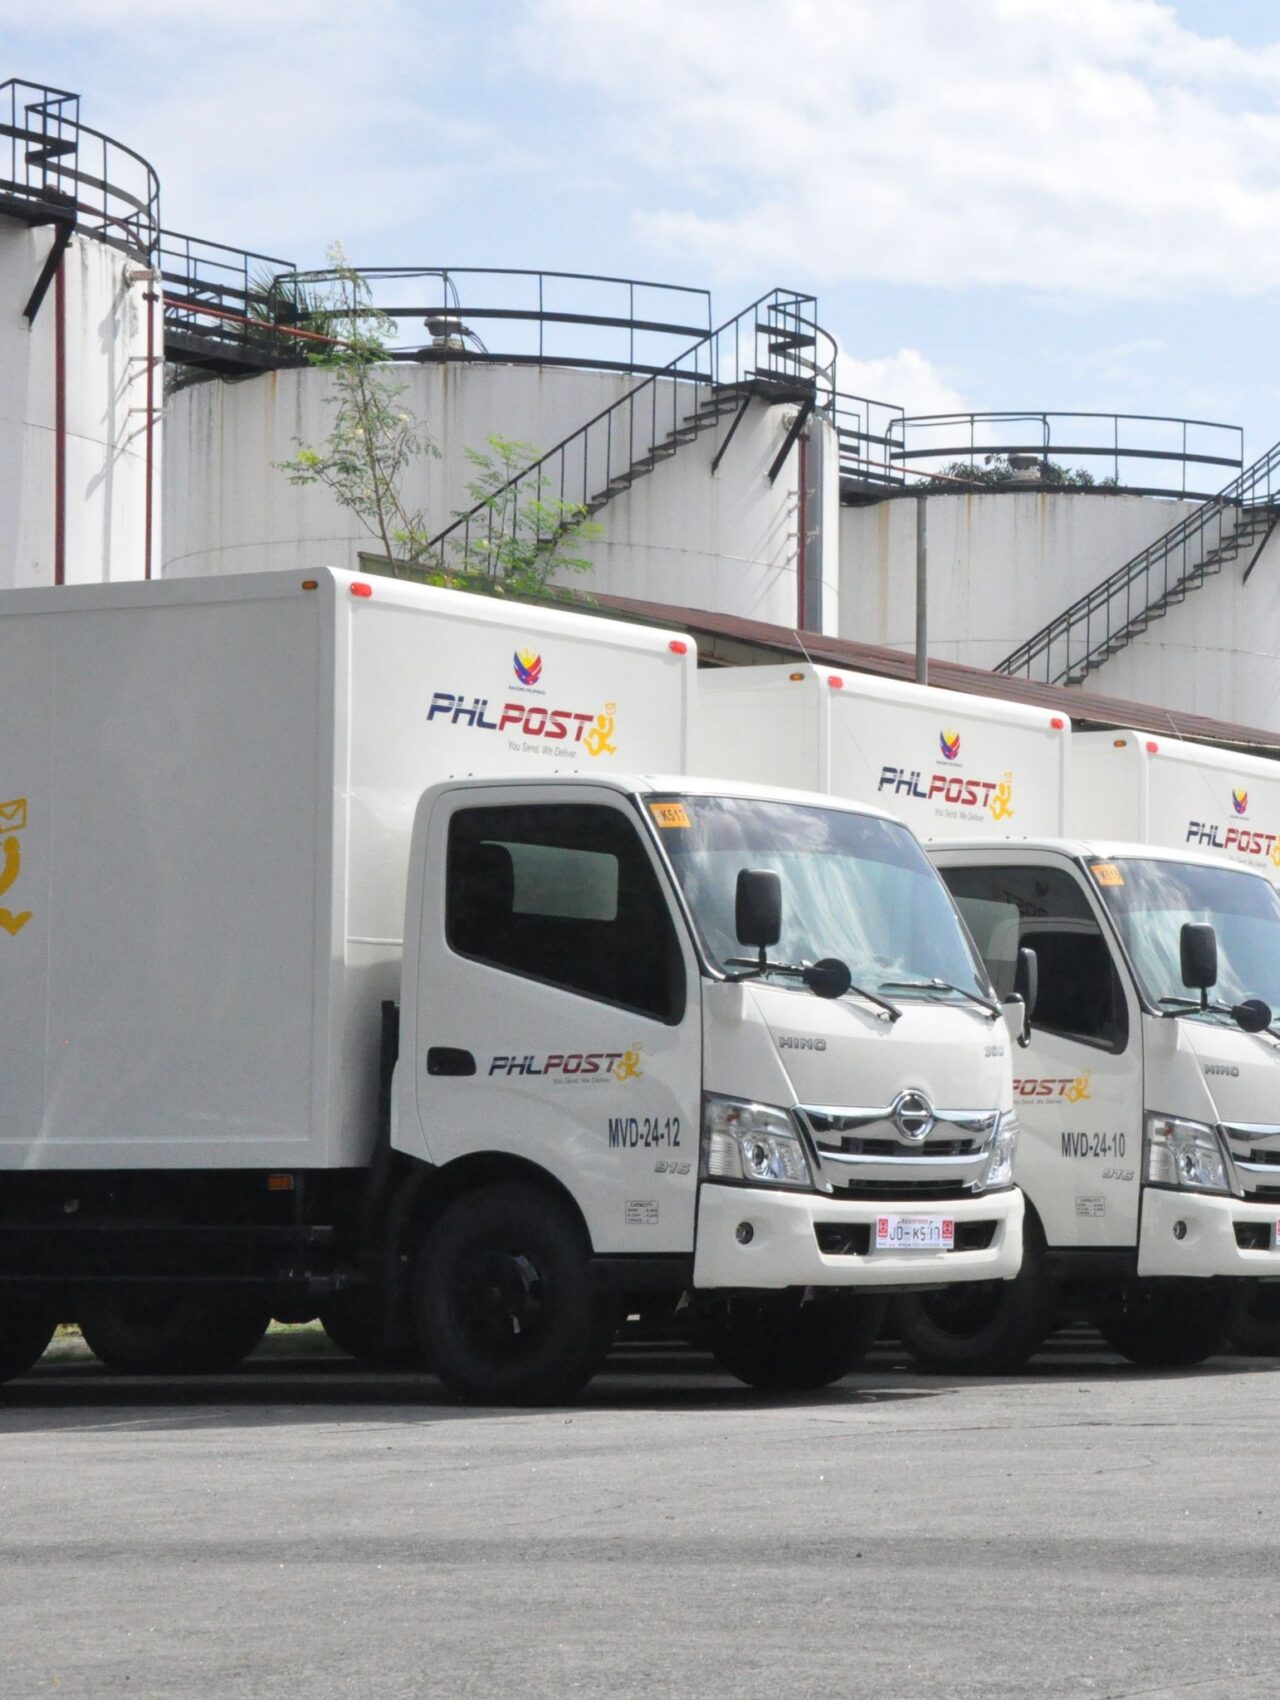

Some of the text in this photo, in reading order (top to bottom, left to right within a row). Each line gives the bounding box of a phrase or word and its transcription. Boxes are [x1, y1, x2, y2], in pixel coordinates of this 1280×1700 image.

[427, 693, 594, 741] PHLPOST
[508, 740, 520, 751] You
[878, 766, 997, 807] PHLPOST
[1186, 821, 1277, 856] PHLPOST
[778, 1036, 826, 1051] HINO
[488, 1053, 623, 1076] PHLPOST
[608, 1117, 680, 1148] MVD-24-12
[1061, 1132, 1126, 1158] MVD-24-10
